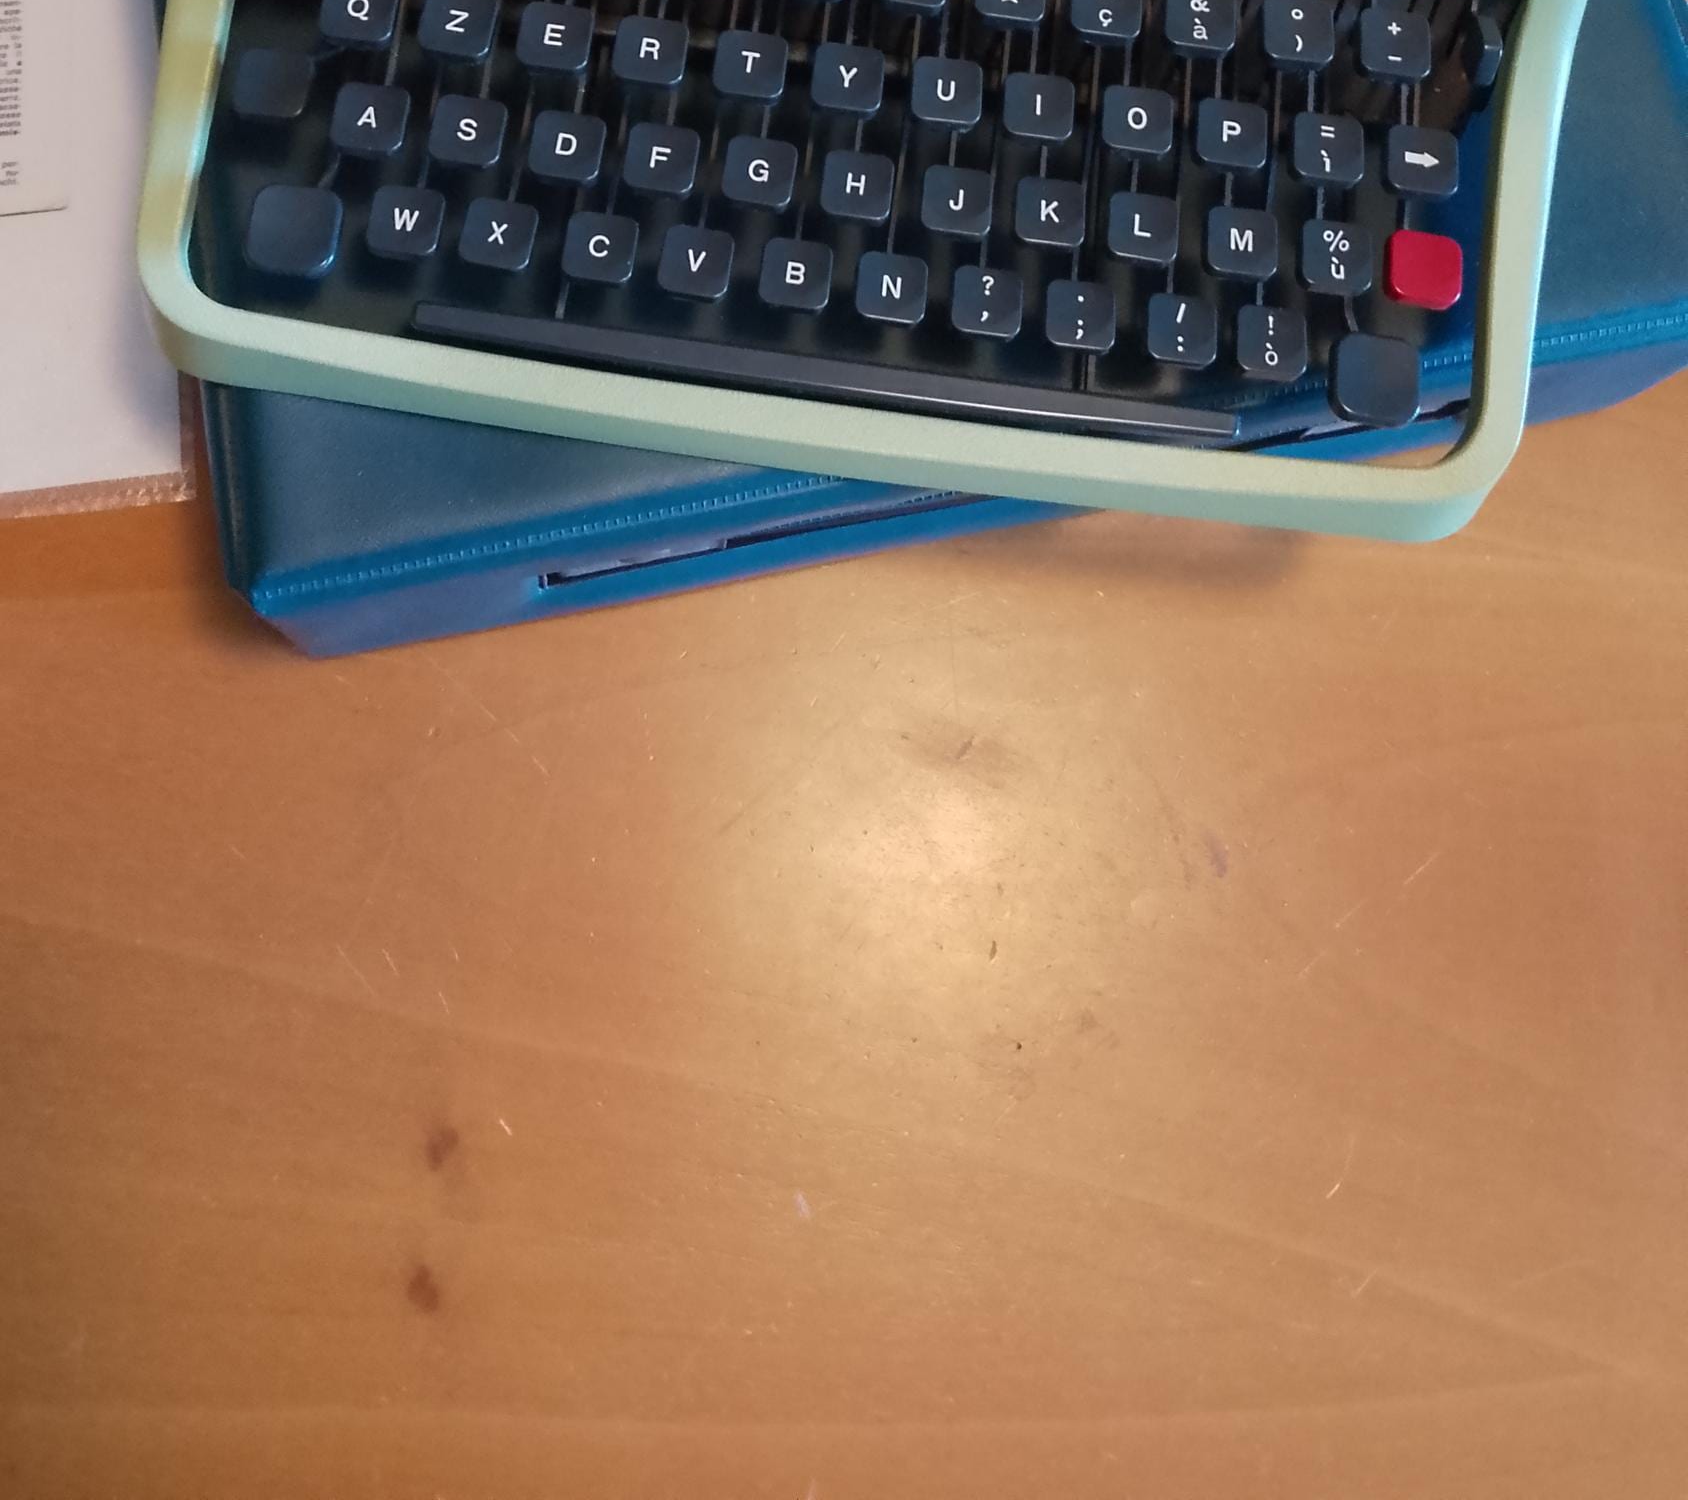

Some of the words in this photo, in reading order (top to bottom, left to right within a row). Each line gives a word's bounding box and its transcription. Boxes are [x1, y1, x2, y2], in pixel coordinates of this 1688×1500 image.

[444, 9, 470, 33] Z
[1098, 8, 1113, 28] ç
[1192, 17, 1209, 40] à
[543, 23, 566, 47] E
[639, 37, 661, 61] R
[741, 50, 761, 74] T
[839, 64, 858, 88] Y
[936, 78, 956, 102] U
[356, 106, 377, 129] A
[456, 118, 478, 141] S
[1127, 106, 1148, 130] O
[1222, 120, 1242, 143] P
[554, 132, 578, 156] D
[649, 145, 672, 169] F
[748, 159, 770, 183] G
[845, 172, 866, 196] H
[948, 188, 965, 211] J
[1040, 199, 1060, 223] K
[393, 207, 420, 232] W
[1133, 213, 1152, 238] L
[487, 220, 509, 245] X
[1230, 227, 1254, 253] M
[1322, 229, 1350, 253] %
[588, 234, 610, 258] C
[687, 248, 707, 273] V
[1330, 256, 1345, 280] ù
[785, 261, 806, 285] B
[881, 274, 902, 299] N
[982, 275, 995, 296] ?
[1264, 342, 1279, 366] ò
